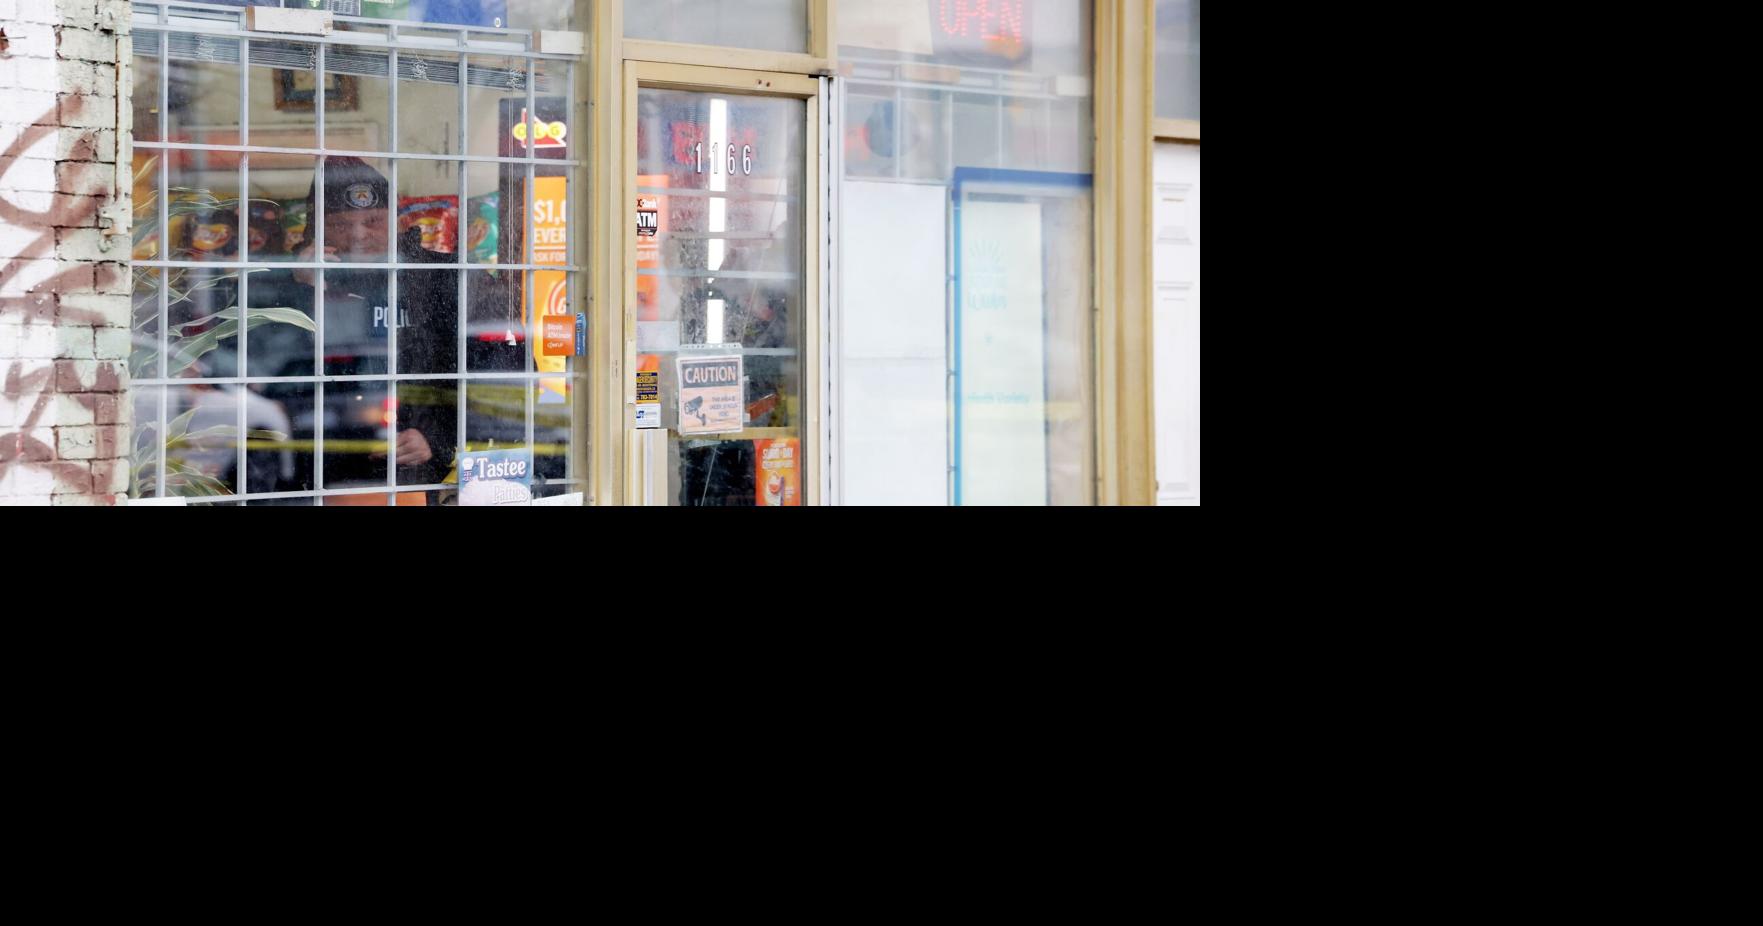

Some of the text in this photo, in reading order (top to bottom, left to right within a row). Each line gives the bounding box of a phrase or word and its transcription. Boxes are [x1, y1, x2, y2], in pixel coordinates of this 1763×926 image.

[696, 142, 752, 175] 1166
[636, 212, 657, 228] ATM
[685, 366, 737, 384] CAUTION
[477, 457, 526, 478] Tastee
